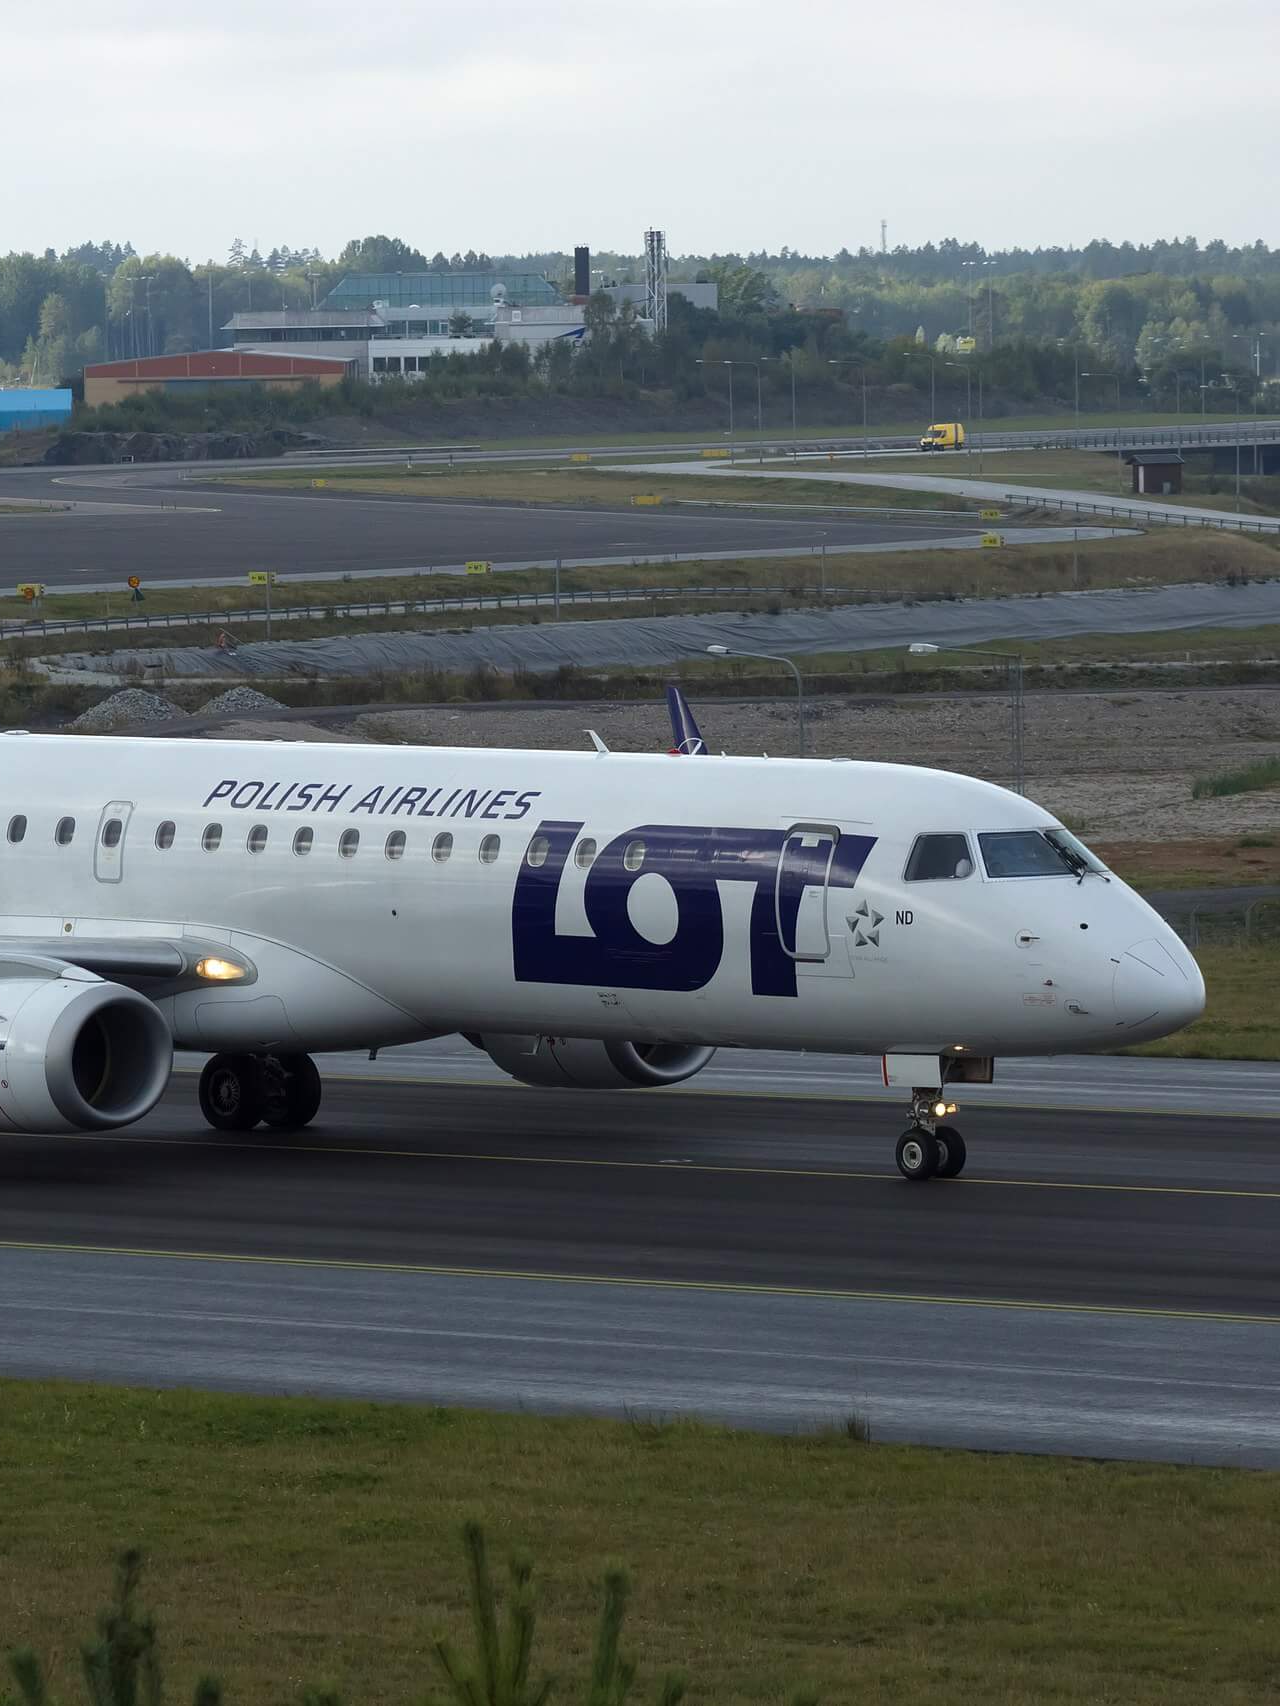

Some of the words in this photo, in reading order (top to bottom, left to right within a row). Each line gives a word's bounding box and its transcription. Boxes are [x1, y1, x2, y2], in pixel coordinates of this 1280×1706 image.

[202, 780, 352, 812] POLISH
[350, 785, 542, 820] AIRLINES
[511, 820, 879, 997] LOT
[895, 910, 914, 925] ND
